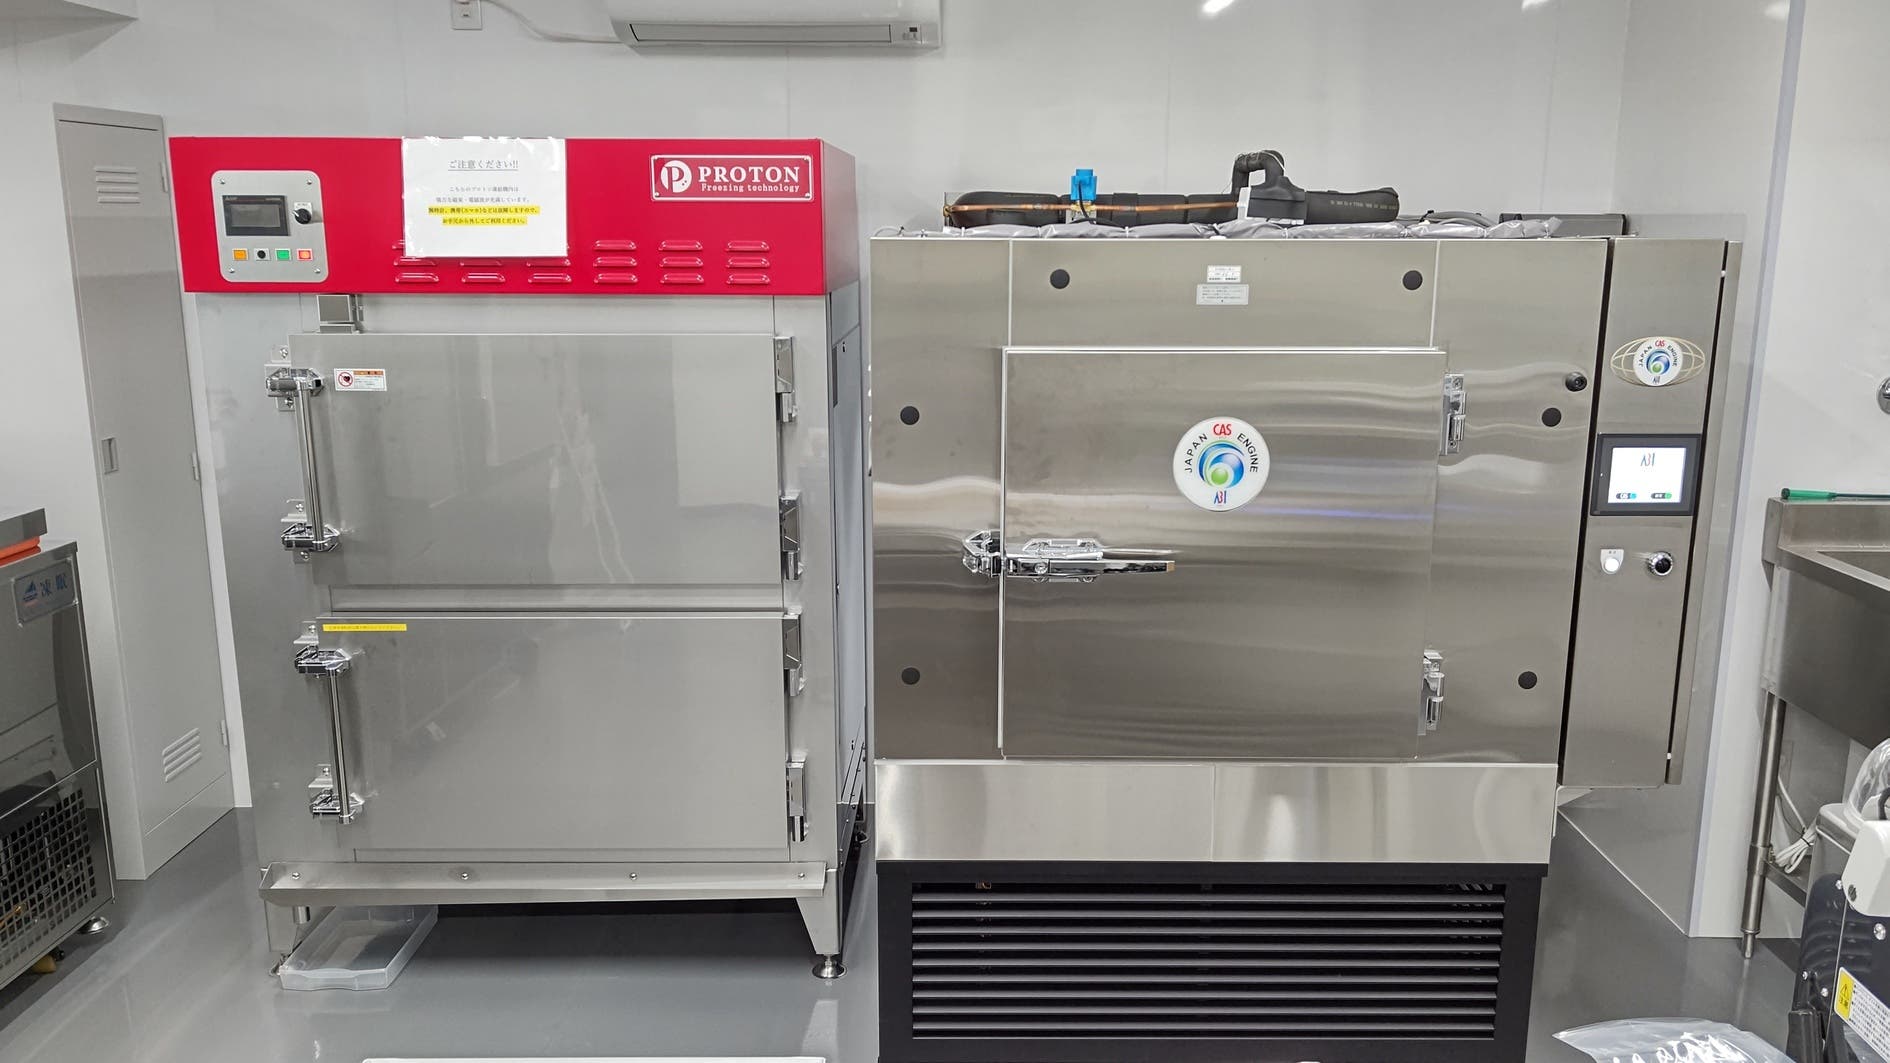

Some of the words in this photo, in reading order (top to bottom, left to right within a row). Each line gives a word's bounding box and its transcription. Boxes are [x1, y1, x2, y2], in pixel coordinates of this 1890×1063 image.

[449, 159, 518, 169] ご注意ください!!
[698, 166, 799, 182] PROTON
[701, 183, 744, 192] Freezing
[747, 183, 799, 193] technology
[1639, 346, 1652, 367] JAPAN
[1654, 339, 1666, 347] CAS
[1667, 345, 1678, 367] ENGINE
[1184, 433, 1208, 473] JAPAN
[1213, 423, 1232, 436] CAS
[1237, 432, 1259, 473] ENGINE
